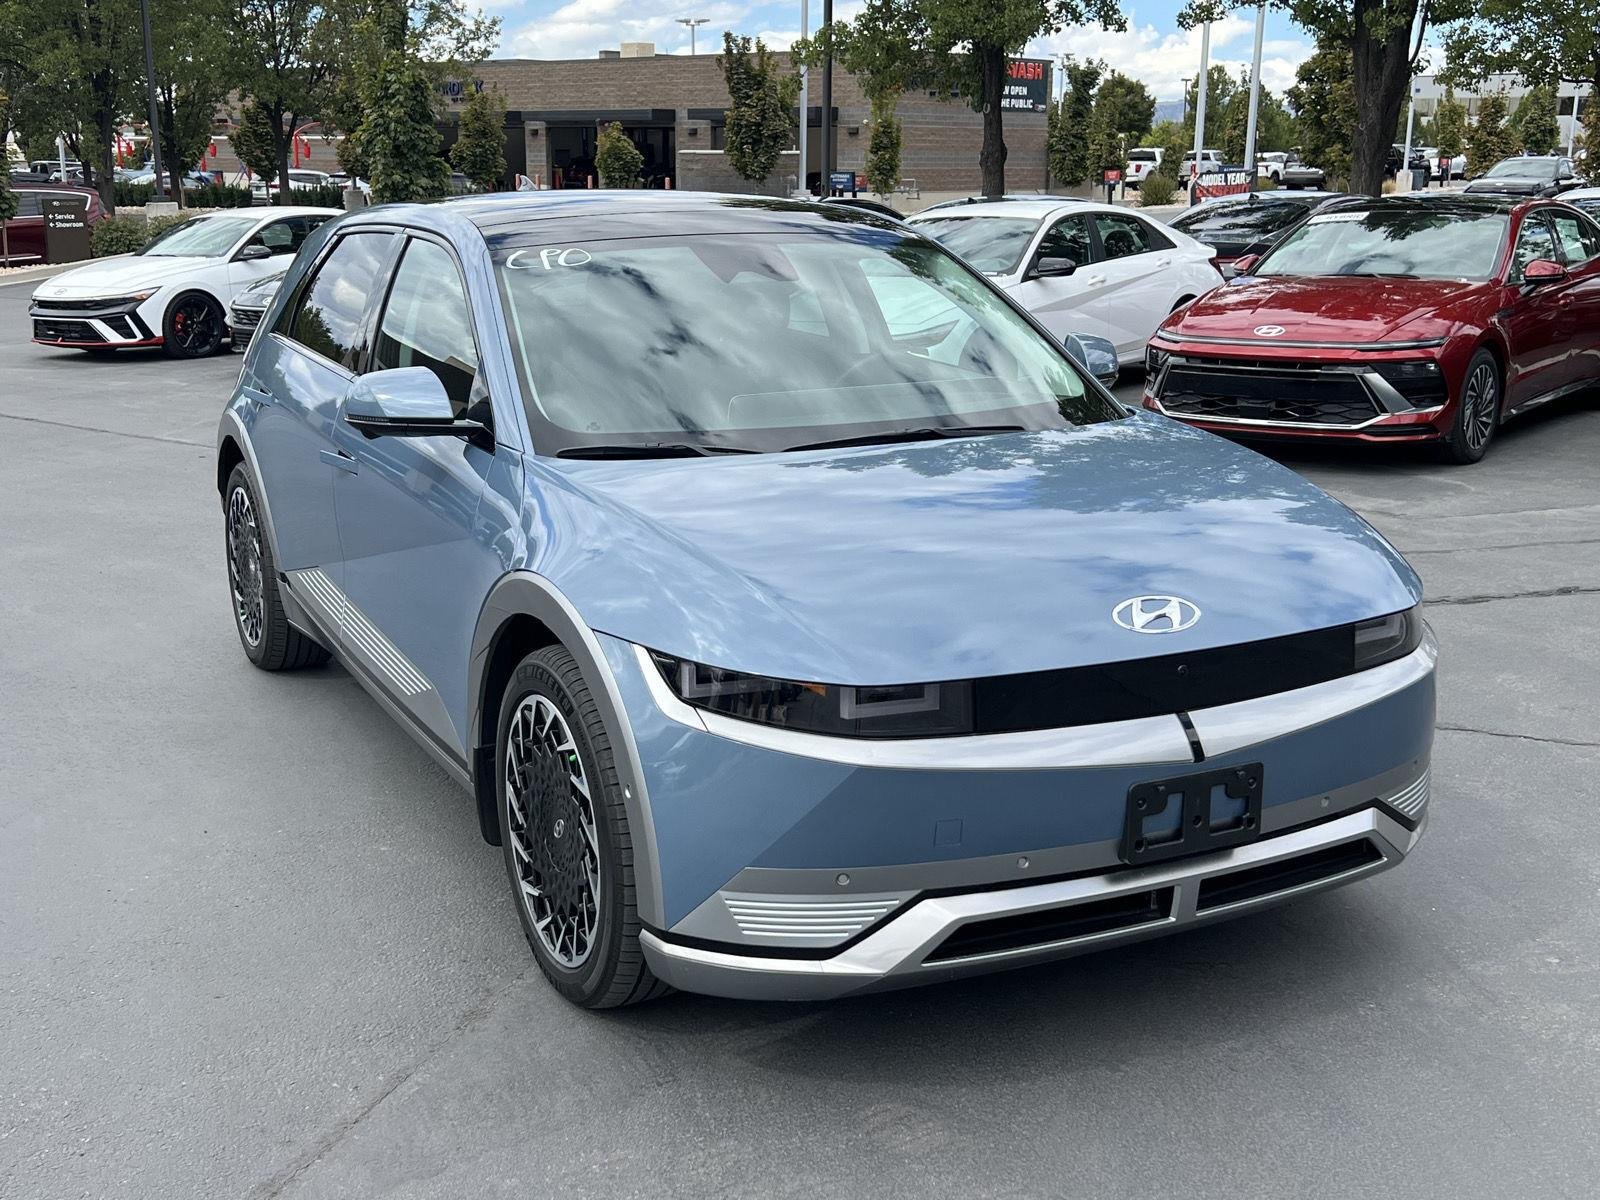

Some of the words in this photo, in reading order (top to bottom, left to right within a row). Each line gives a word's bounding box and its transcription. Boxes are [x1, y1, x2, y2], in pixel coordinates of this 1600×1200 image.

[1010, 85, 1027, 95] OPEN
[1000, 98, 1010, 108] HE
[1010, 98, 1033, 108] PUBLIC
[1202, 173, 1226, 186] MODEL
[1227, 172, 1246, 185] YEAR
[506, 248, 592, 269] CPO
